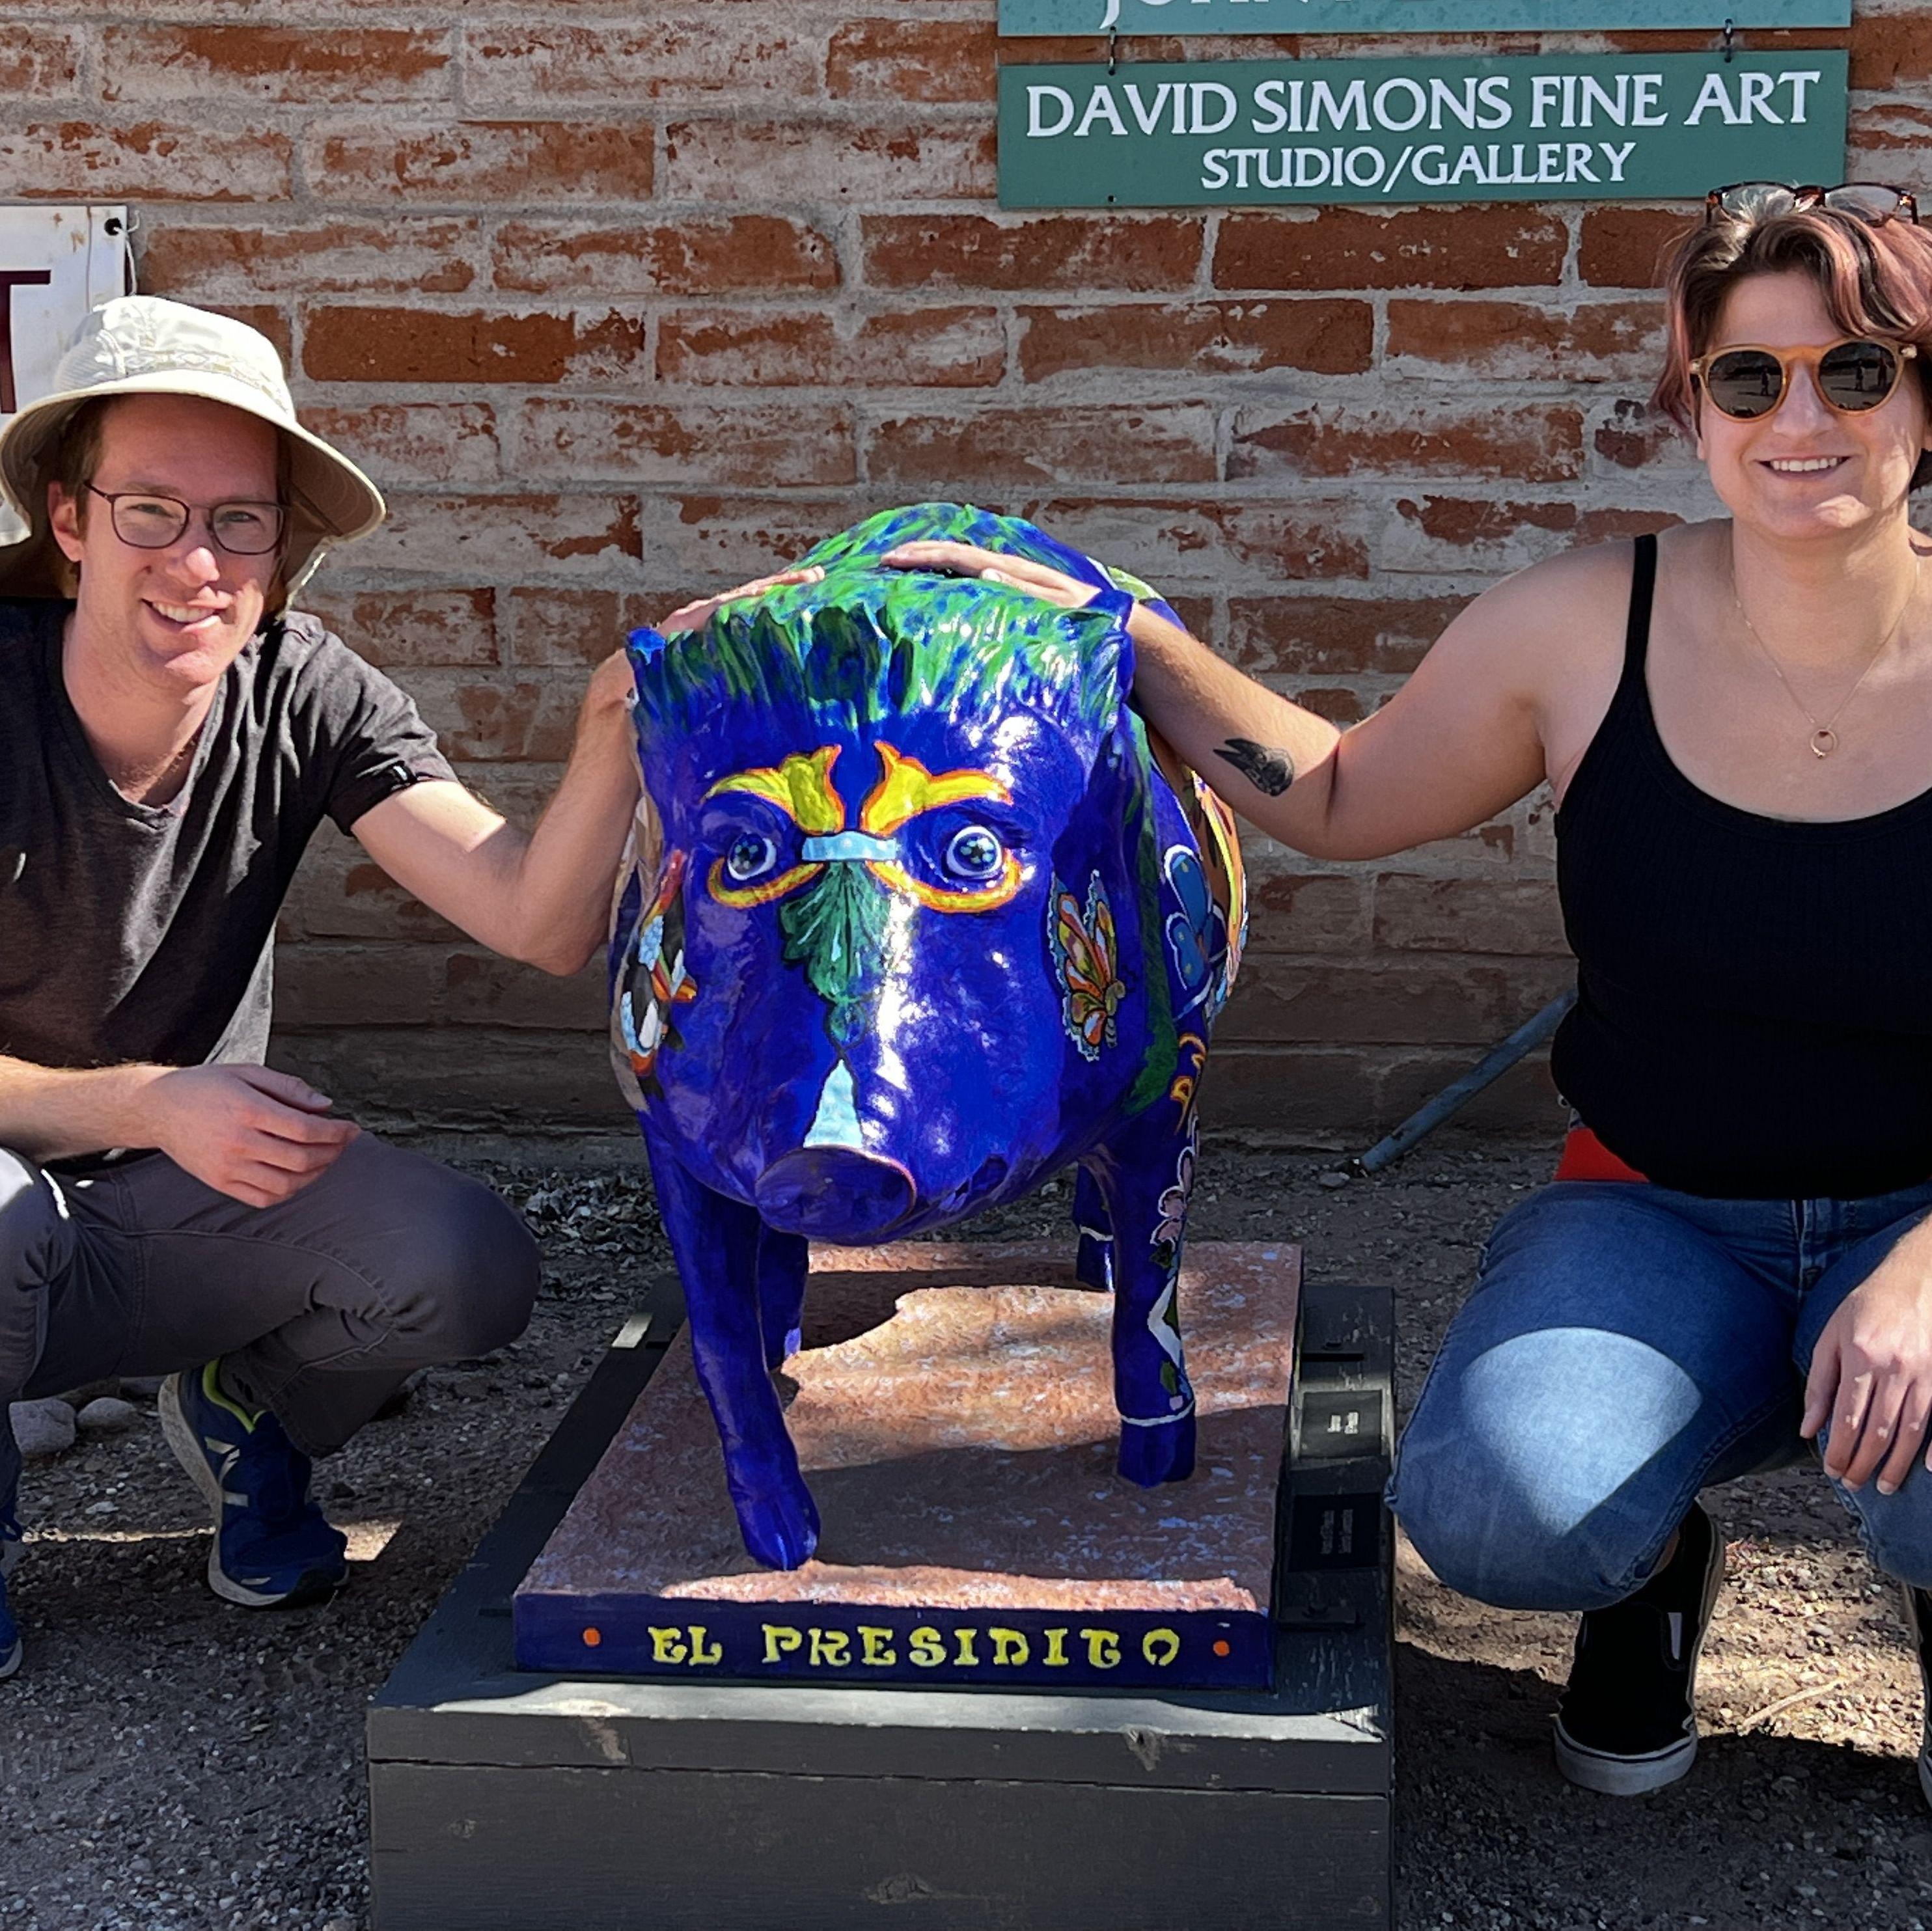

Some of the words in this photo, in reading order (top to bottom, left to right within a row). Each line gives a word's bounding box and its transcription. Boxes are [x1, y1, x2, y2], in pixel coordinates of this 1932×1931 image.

[1027, 82, 1237, 137] DAVID
[1252, 77, 1511, 134] SIMONS
[1529, 74, 1668, 129] FINE
[1683, 71, 1821, 126] ART
[1201, 142, 1637, 193] STUDIO/GALLERY
[647, 1625, 723, 1667] EL
[761, 1623, 1181, 1669] PRESIDITO
